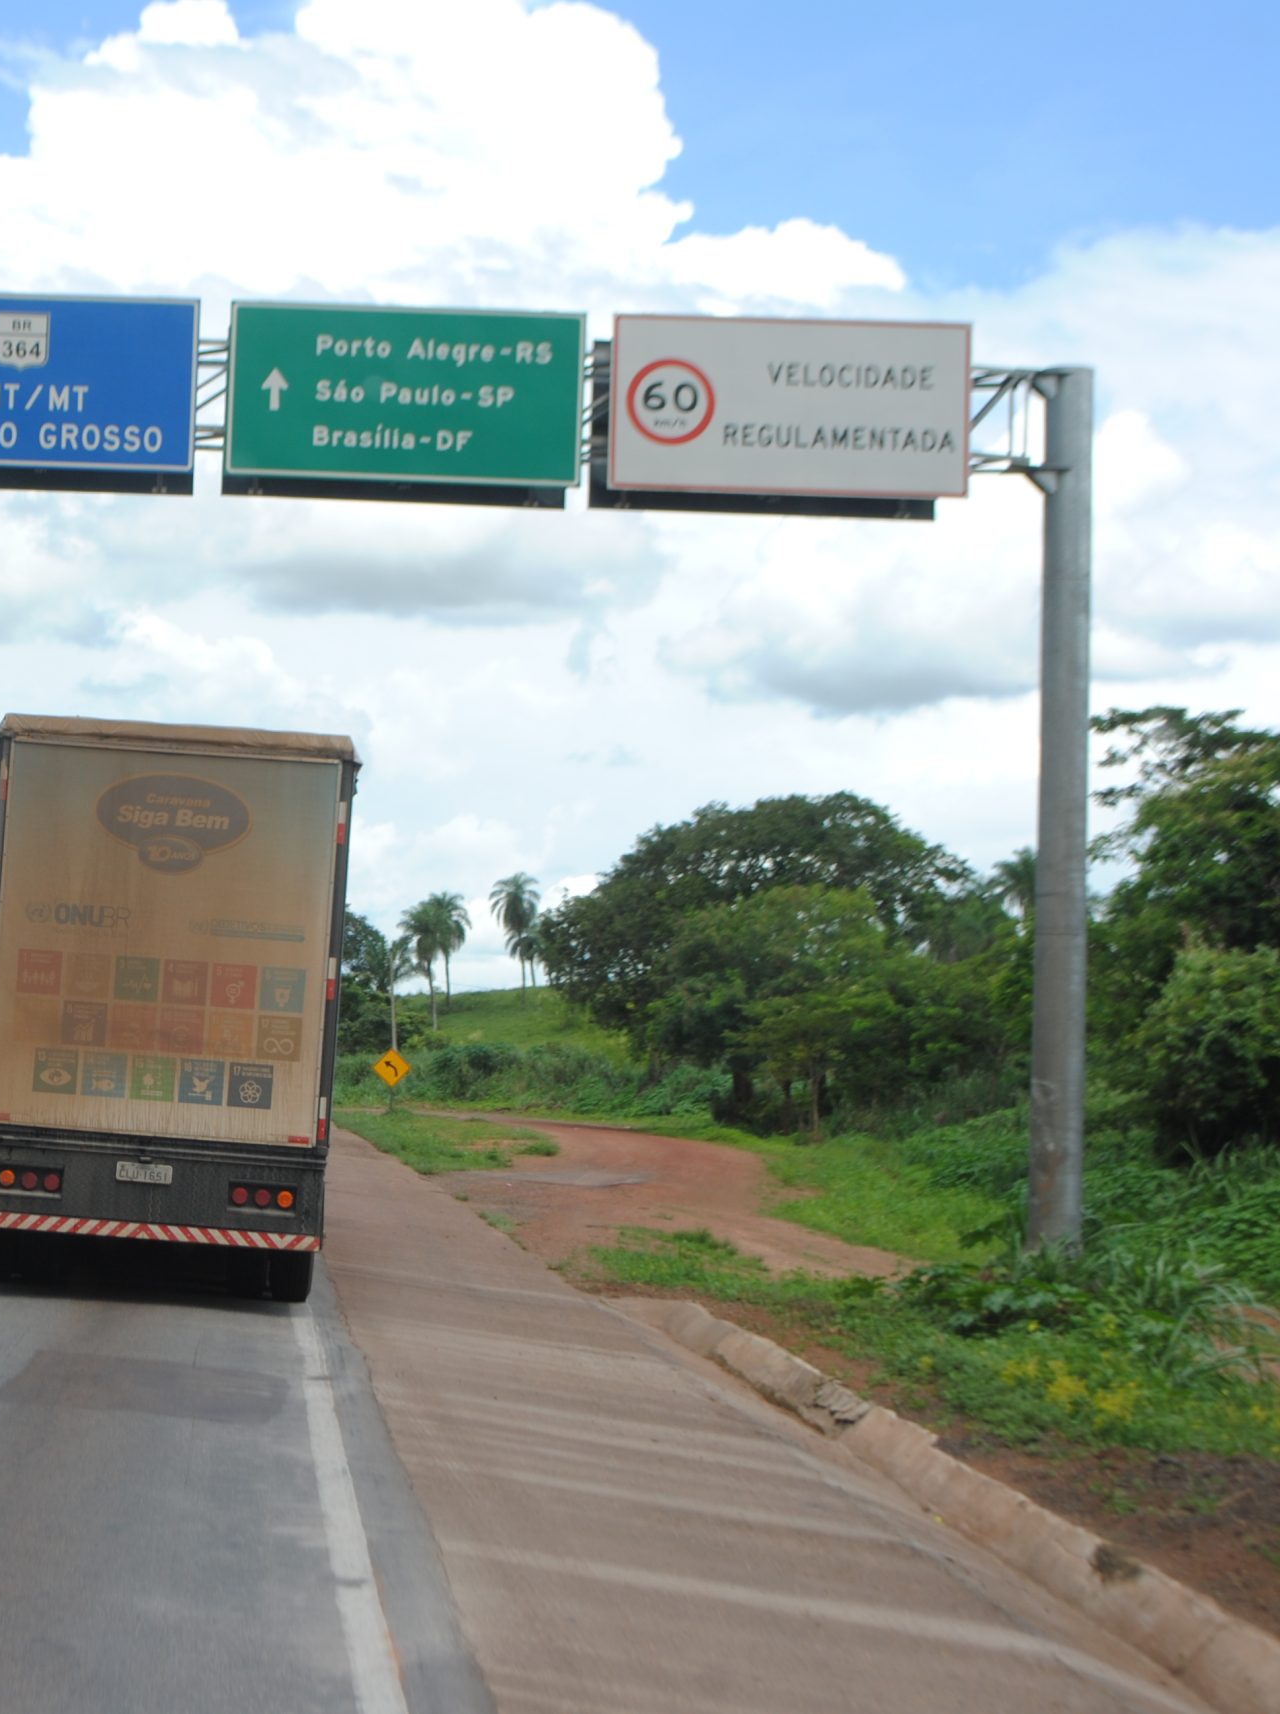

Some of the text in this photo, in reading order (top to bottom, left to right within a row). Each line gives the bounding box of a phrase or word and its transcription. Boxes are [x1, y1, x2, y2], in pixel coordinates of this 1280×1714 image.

[11, 318, 32, 331] BR
[2, 339, 41, 359] 364
[315, 334, 553, 367] Porto Alegre-RS
[767, 361, 936, 392] VELOCIDADE
[379, 381, 515, 408] Paulo-SP
[642, 381, 699, 413] 60
[38, 422, 163, 453] GROSSO
[312, 423, 473, 453] Brasília-DF
[722, 423, 956, 453] REGULAMENTADA
[144, 793, 212, 808] Caravana
[117, 805, 230, 830] Siga Bem
